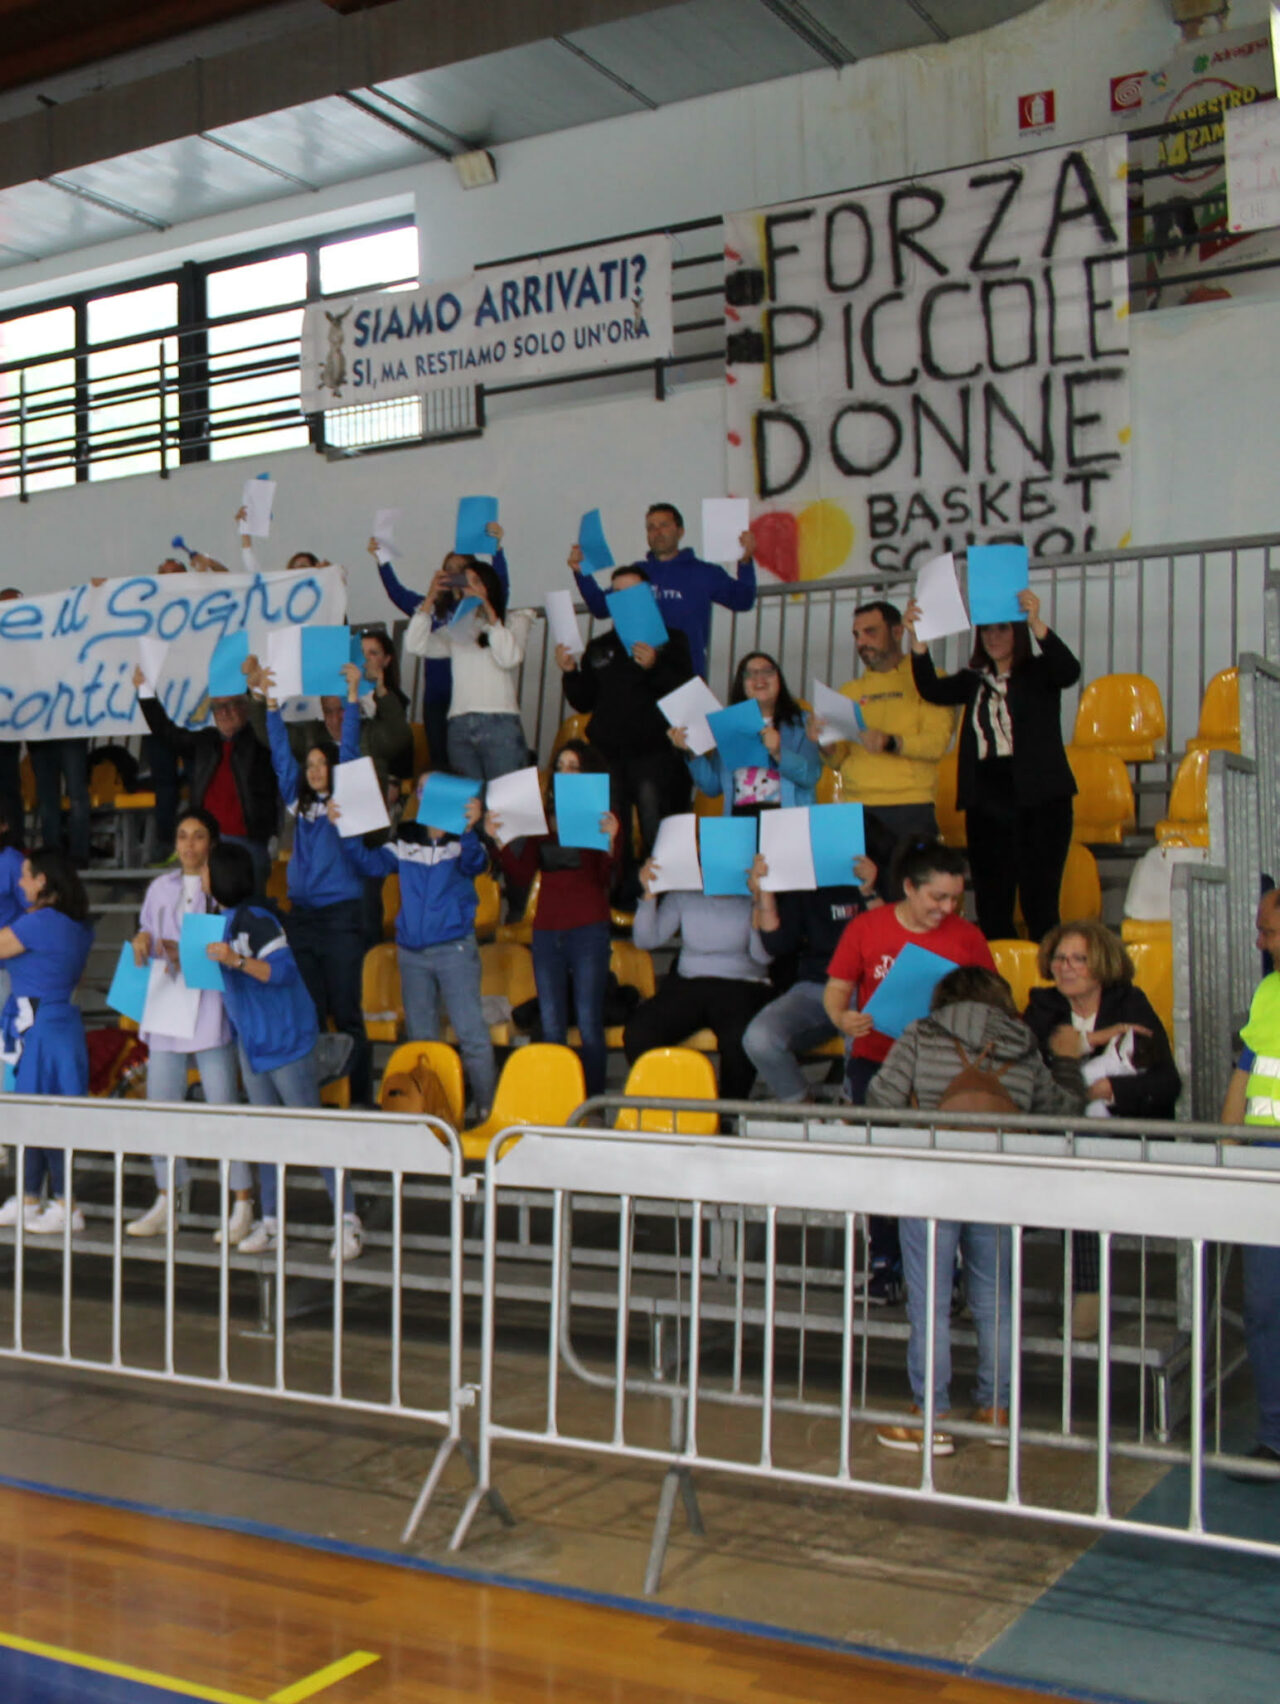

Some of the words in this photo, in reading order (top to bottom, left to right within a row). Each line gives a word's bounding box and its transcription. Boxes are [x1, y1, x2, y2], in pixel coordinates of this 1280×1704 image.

[764, 150, 1118, 300] FORZA
[353, 292, 461, 347] SIAMO
[475, 253, 647, 326] ARRIVATI?
[381, 359, 408, 382] MA
[416, 341, 506, 377] RESTIAMO
[513, 330, 565, 359] SOLO
[574, 315, 649, 349] UN'ORA
[764, 254, 1129, 401] PICCOLE
[756, 368, 1123, 497] DONNE
[866, 472, 1111, 539] BASKET
